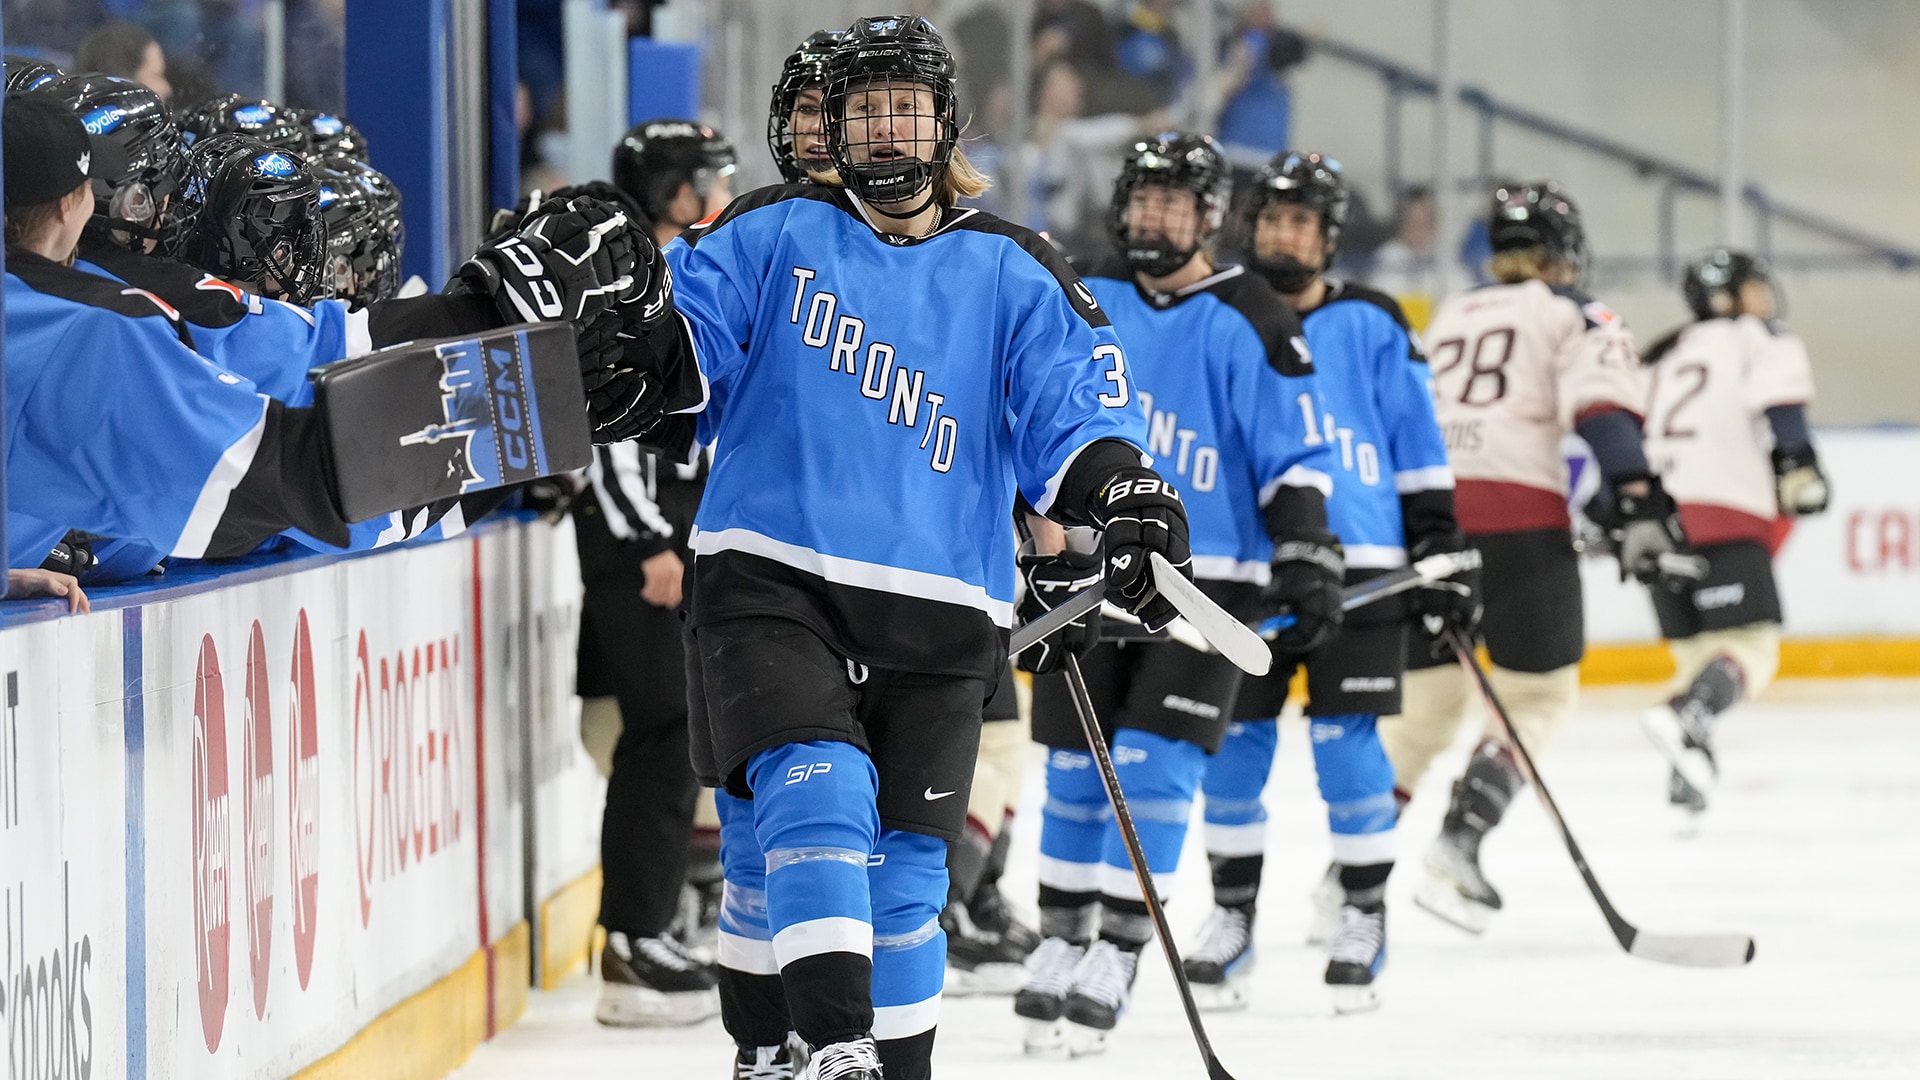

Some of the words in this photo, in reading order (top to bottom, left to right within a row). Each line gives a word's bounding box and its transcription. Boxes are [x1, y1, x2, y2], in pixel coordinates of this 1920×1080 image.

[868, 19, 898, 32] 34
[81, 109, 120, 135] oyale
[498, 243, 564, 318] CC
[789, 265, 959, 474] TORONTO
[489, 348, 529, 470] CCM
[1847, 509, 1920, 575] CA
